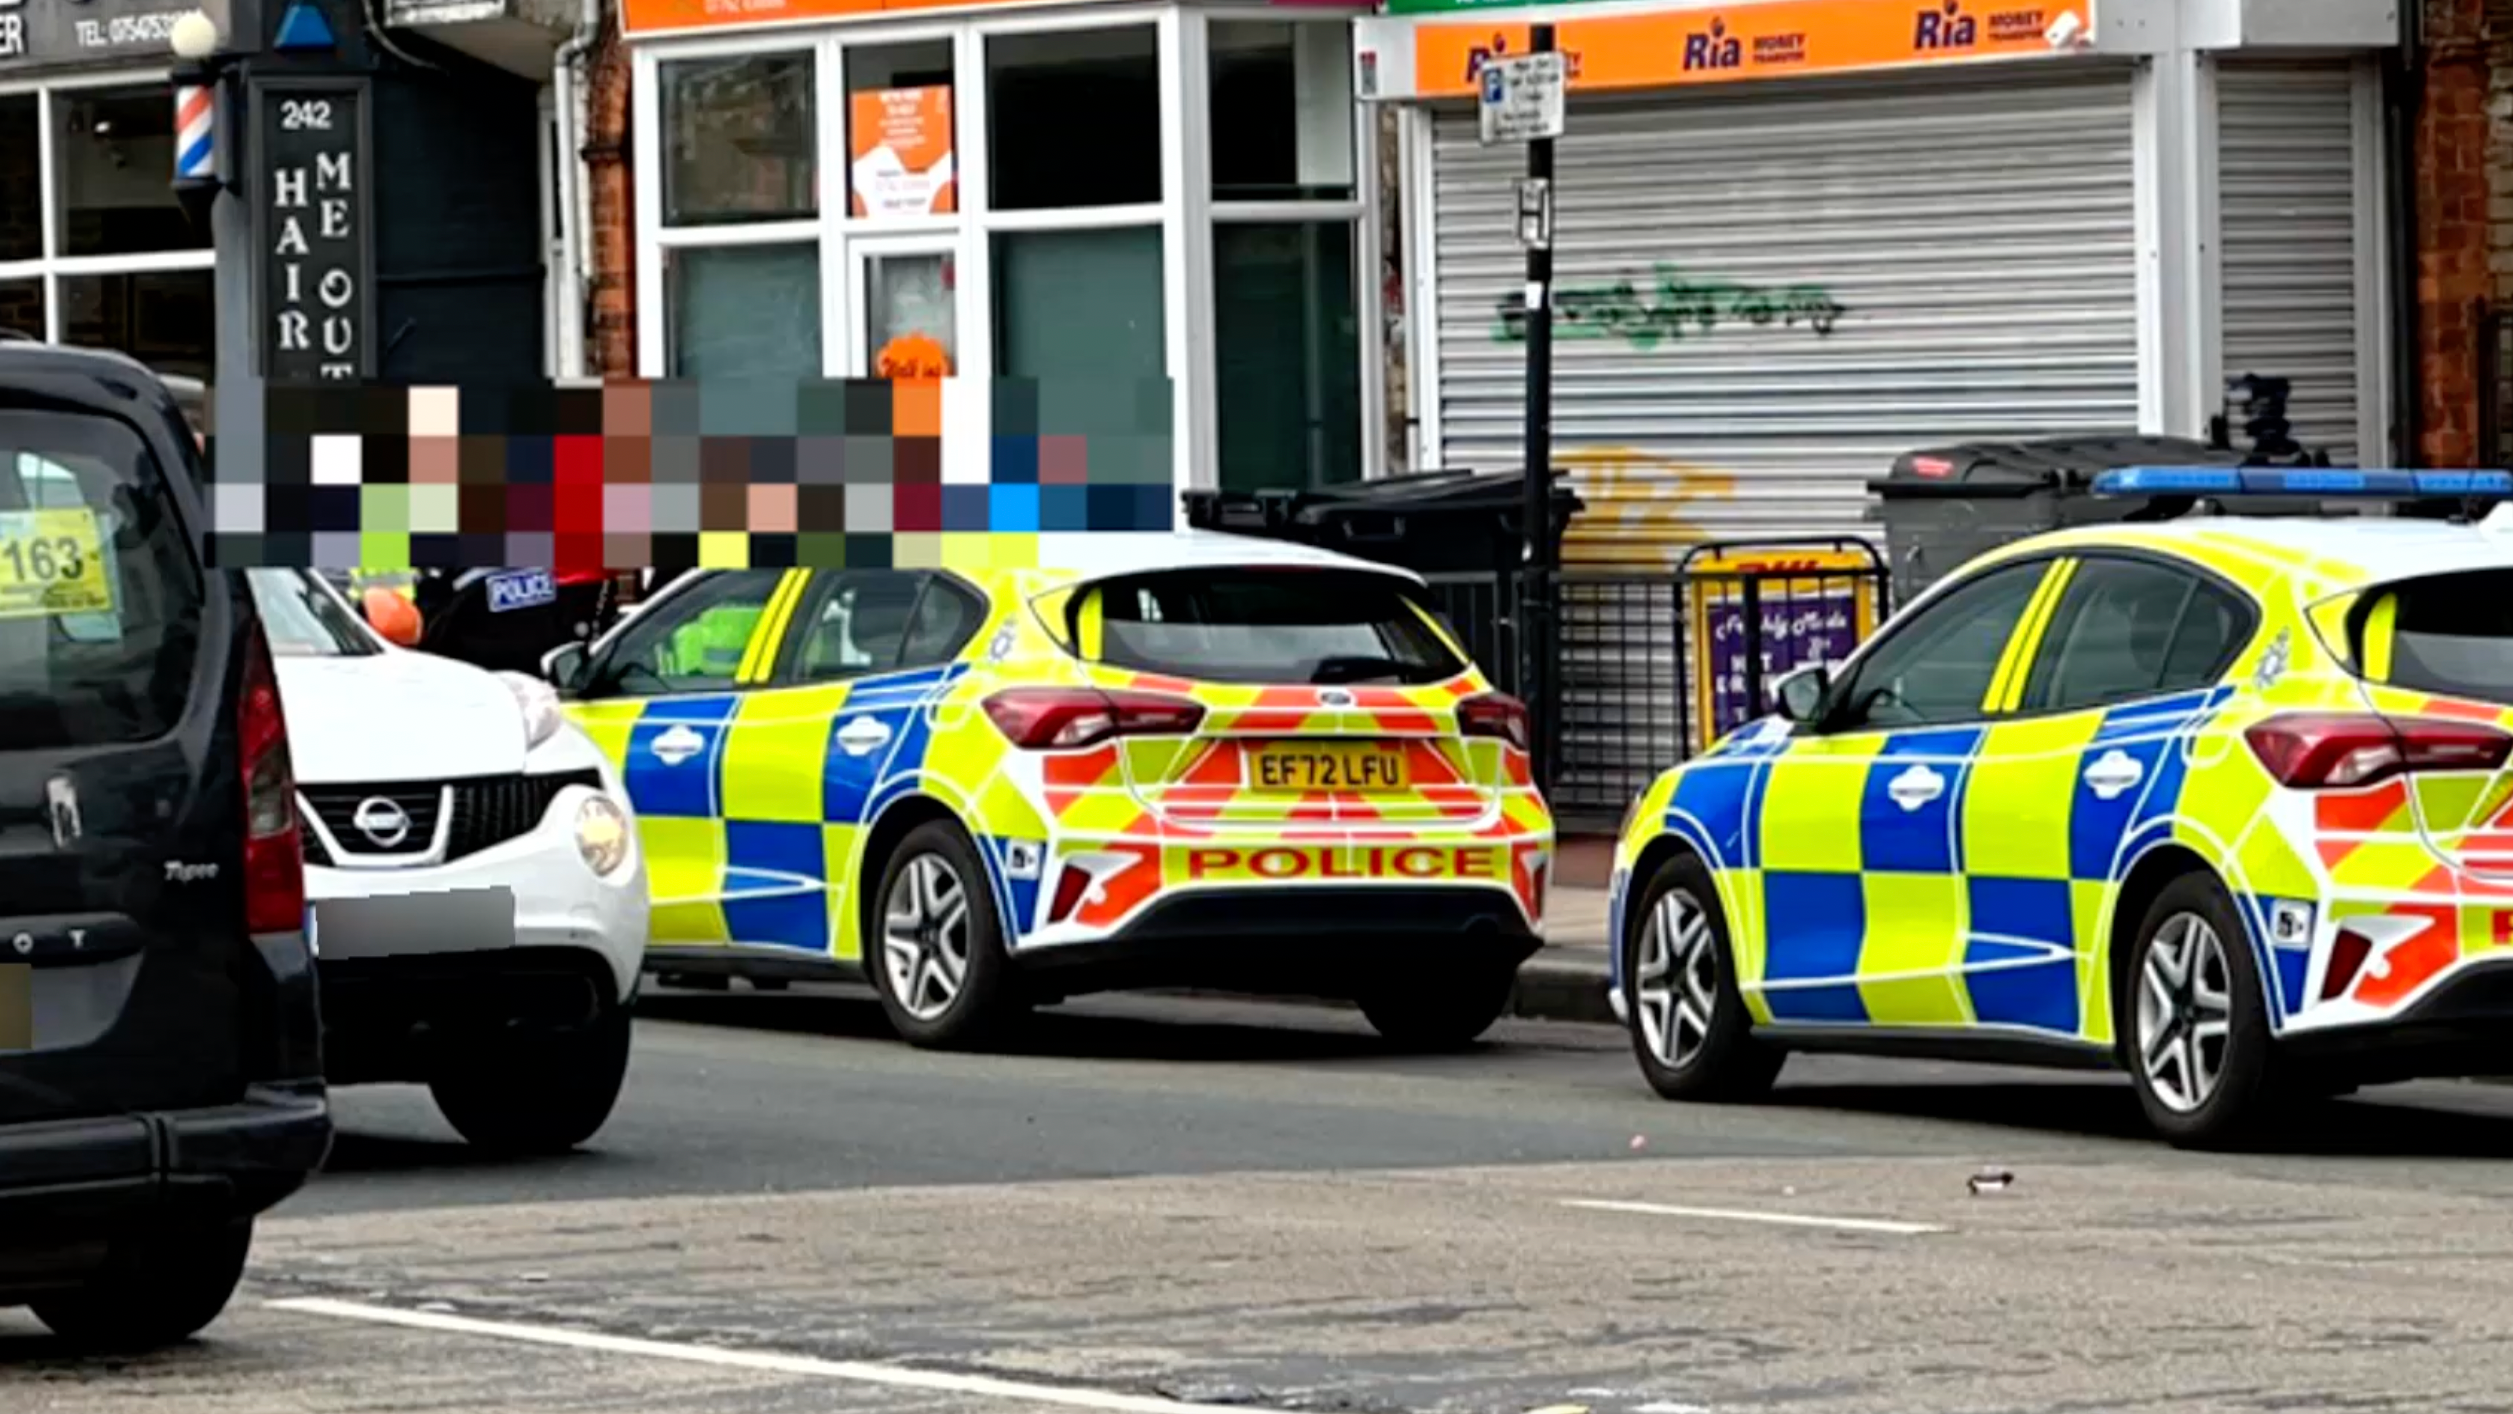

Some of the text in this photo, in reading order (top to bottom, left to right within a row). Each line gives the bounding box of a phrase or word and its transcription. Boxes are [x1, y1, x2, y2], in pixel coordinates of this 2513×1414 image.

[1684, 15, 1740, 70] Ria
[1914, 0, 1977, 49] Ria
[281, 101, 332, 129] 242
[316, 152, 352, 237] ME
[274, 168, 310, 350] HAIR
[2, 536, 84, 582] 163
[492, 574, 553, 606] POLICE
[1260, 754, 1399, 787] EF72 LFU
[1188, 846, 1496, 879] POLICE
